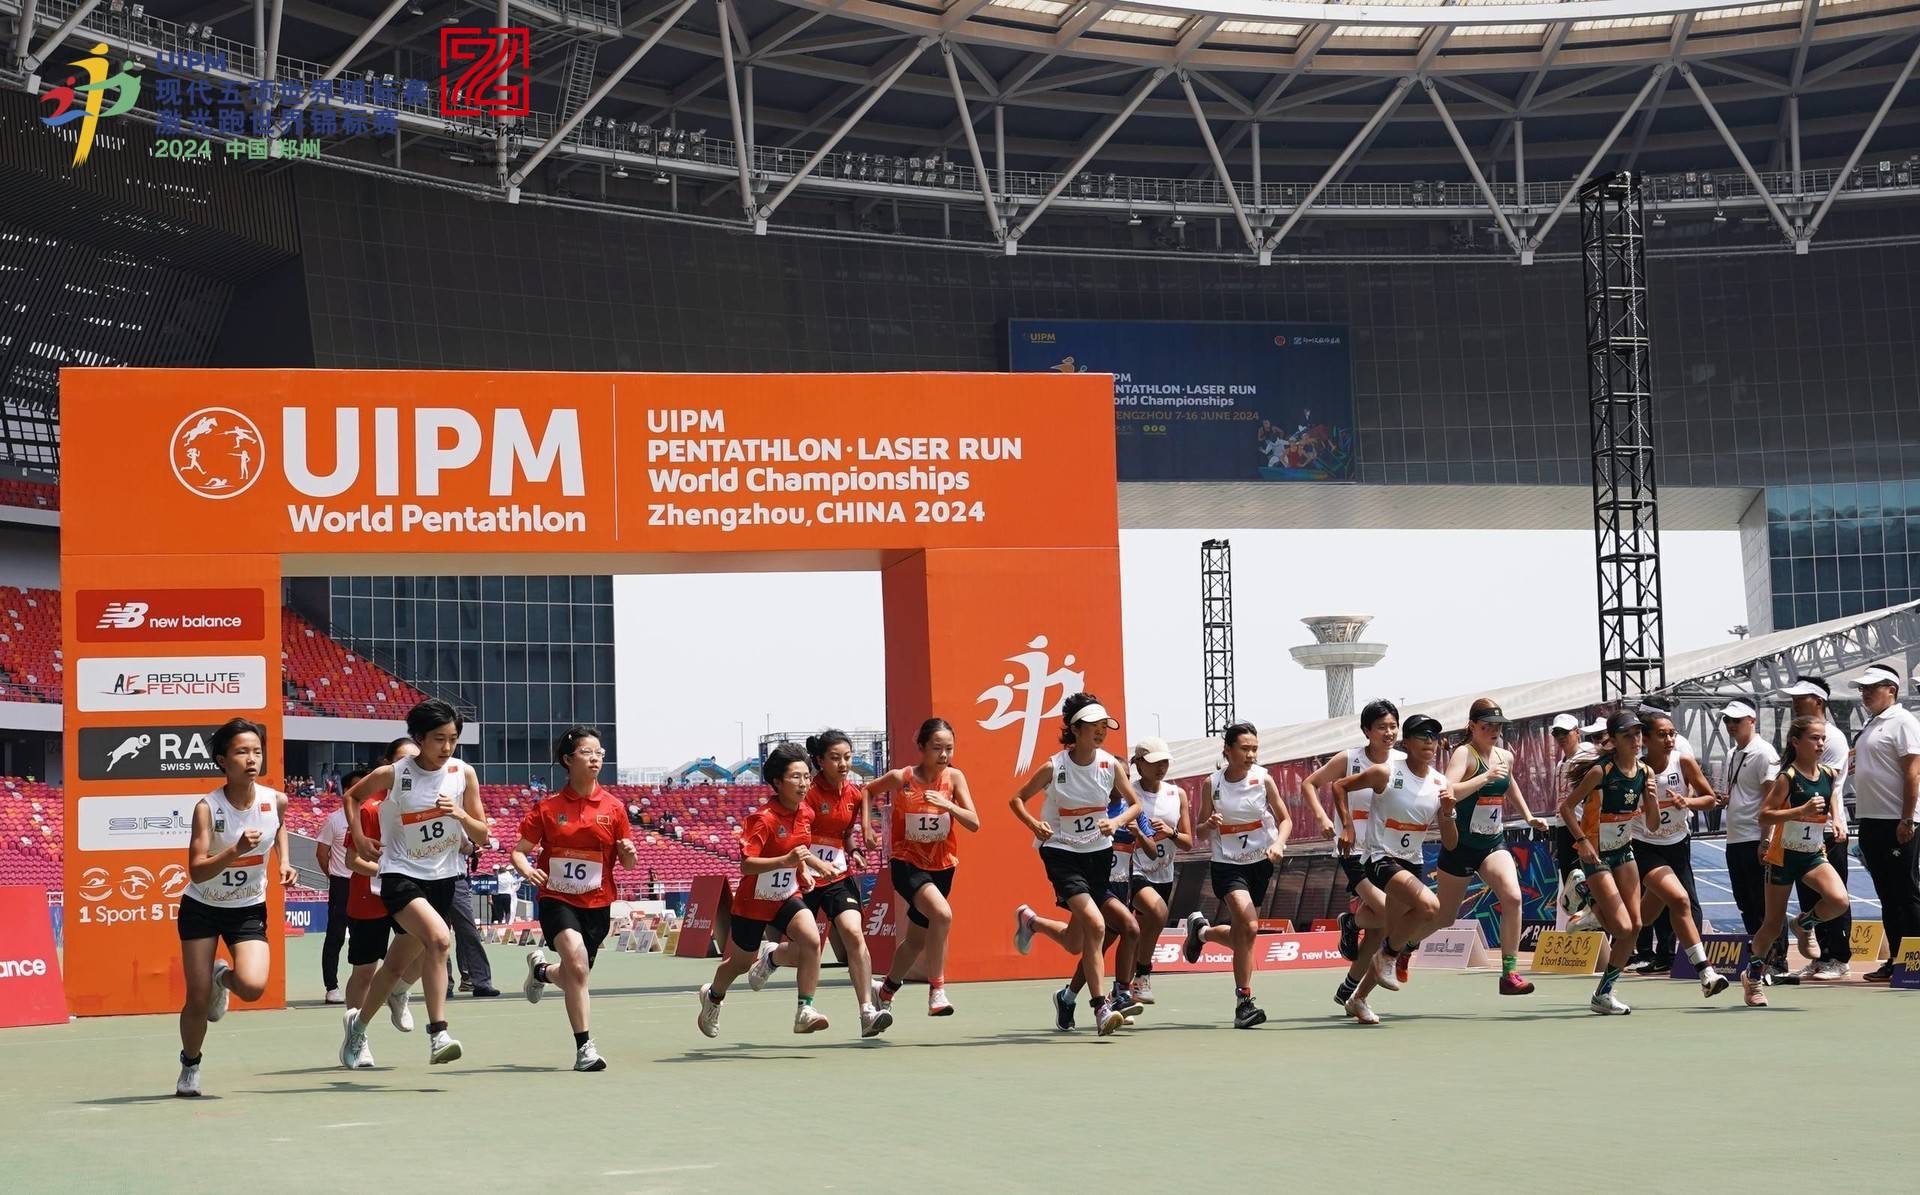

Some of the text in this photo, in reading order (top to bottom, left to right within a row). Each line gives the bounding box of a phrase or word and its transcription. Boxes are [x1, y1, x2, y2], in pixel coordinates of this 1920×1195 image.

[1113, 373, 1131, 382] PM
[1229, 385, 1257, 395] RUN
[1113, 395, 1235, 407] orld Championships
[647, 409, 725, 433] UIPM
[1116, 411, 1260, 421] ENGZHOU 7-16 JUNE 2024
[282, 406, 585, 497] UIPM
[959, 436, 1022, 460] RUN
[648, 466, 970, 496] World Championships
[287, 504, 586, 533] World Pentathlon
[647, 500, 985, 531] Zhengzhou, CHINA 2024
[150, 617, 178, 628] new
[182, 615, 242, 628] balance
[147, 682, 240, 695] FENCING
[160, 733, 210, 760] RA
[160, 763, 191, 771] SWISS
[1489, 808, 1498, 823] 4
[1660, 811, 1671, 825] 2
[419, 821, 445, 843] 18
[918, 816, 940, 832] 13
[1074, 816, 1096, 833] 12
[1616, 823, 1626, 838] 3
[1400, 833, 1411, 848] 6
[1801, 825, 1811, 841] 1
[1238, 834, 1249, 850] 7
[817, 848, 834, 863] 14
[1156, 844, 1166, 858] 8
[222, 870, 248, 887] 19
[563, 861, 587, 880] 16
[771, 872, 792, 889] 15
[79, 906, 92, 923] 1
[95, 905, 147, 927] Sport
[151, 903, 164, 920] 5
[285, 910, 311, 926] ZHOU
[1302, 951, 1322, 961] new
[0, 958, 47, 978] ance
